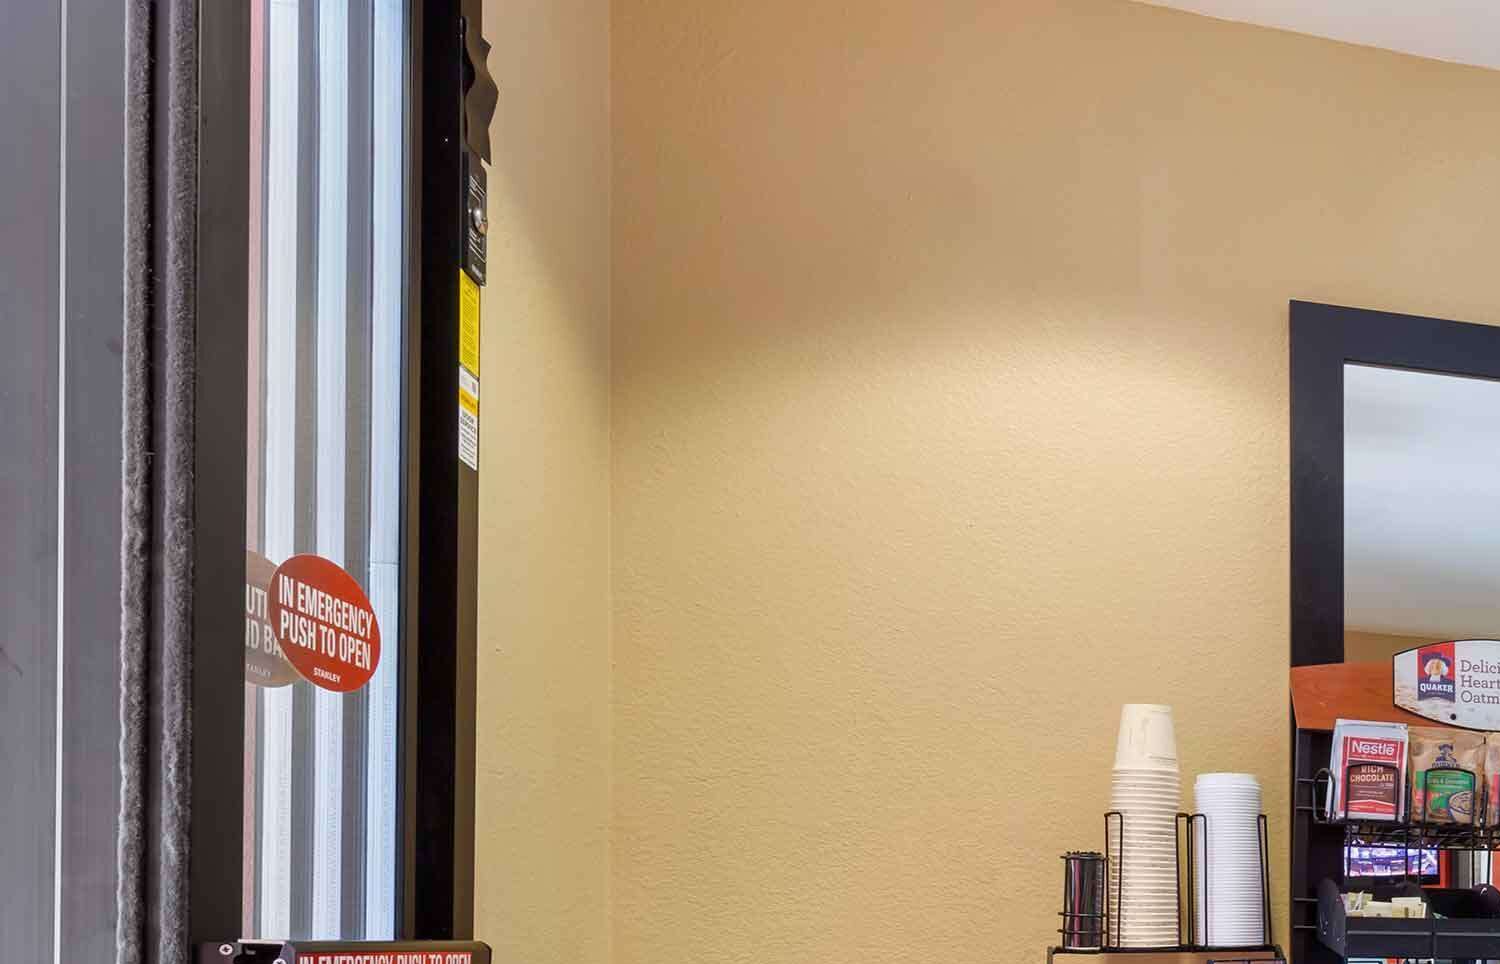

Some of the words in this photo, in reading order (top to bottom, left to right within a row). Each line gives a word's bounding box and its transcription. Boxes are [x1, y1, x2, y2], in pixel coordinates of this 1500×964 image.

[279, 574, 294, 608] IN
[297, 582, 373, 640] EMERGENCY
[280, 610, 316, 651] PUSH
[320, 625, 337, 658] TO
[340, 634, 371, 671] OPEN
[1420, 683, 1453, 693] QUAKER
